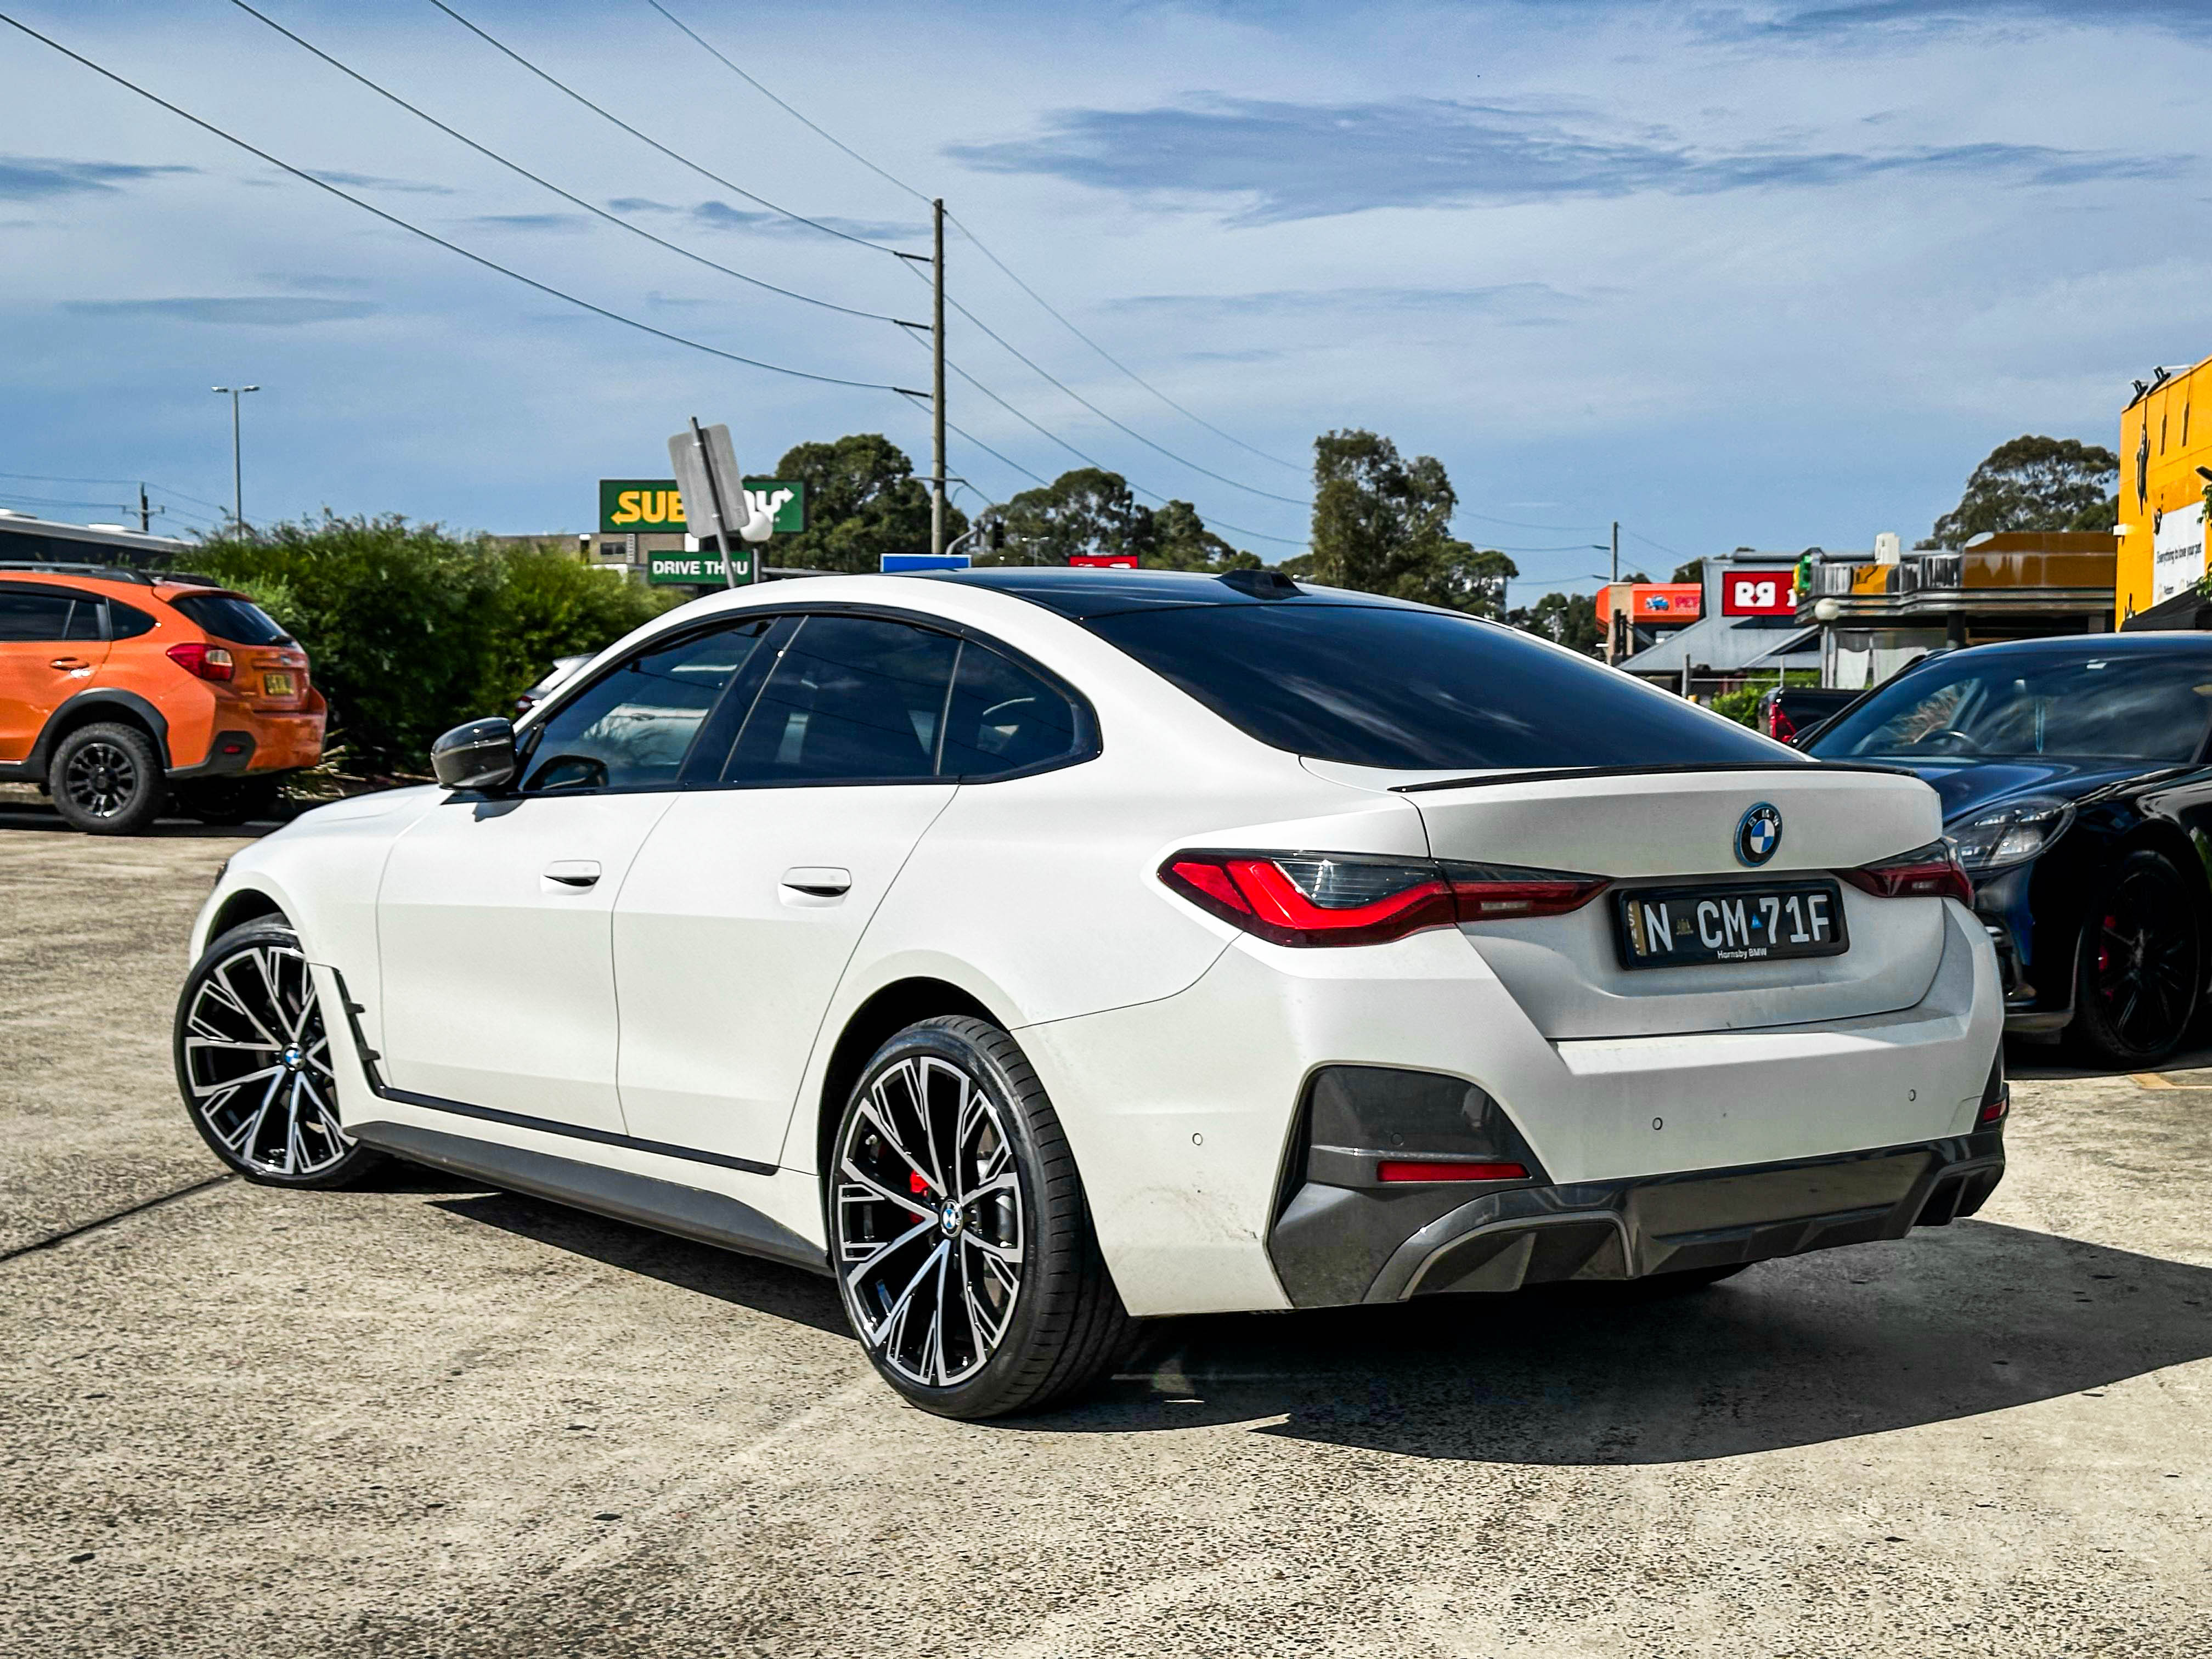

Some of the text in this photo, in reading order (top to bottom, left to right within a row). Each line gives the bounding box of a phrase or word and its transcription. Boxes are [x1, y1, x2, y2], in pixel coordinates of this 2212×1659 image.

[652, 560, 701, 575] DRIVE
[1644, 903, 1673, 952] N
[1697, 899, 1750, 949] CM
[1759, 895, 1829, 945] 71F
[1717, 947, 1767, 960] Hornsby BMW
